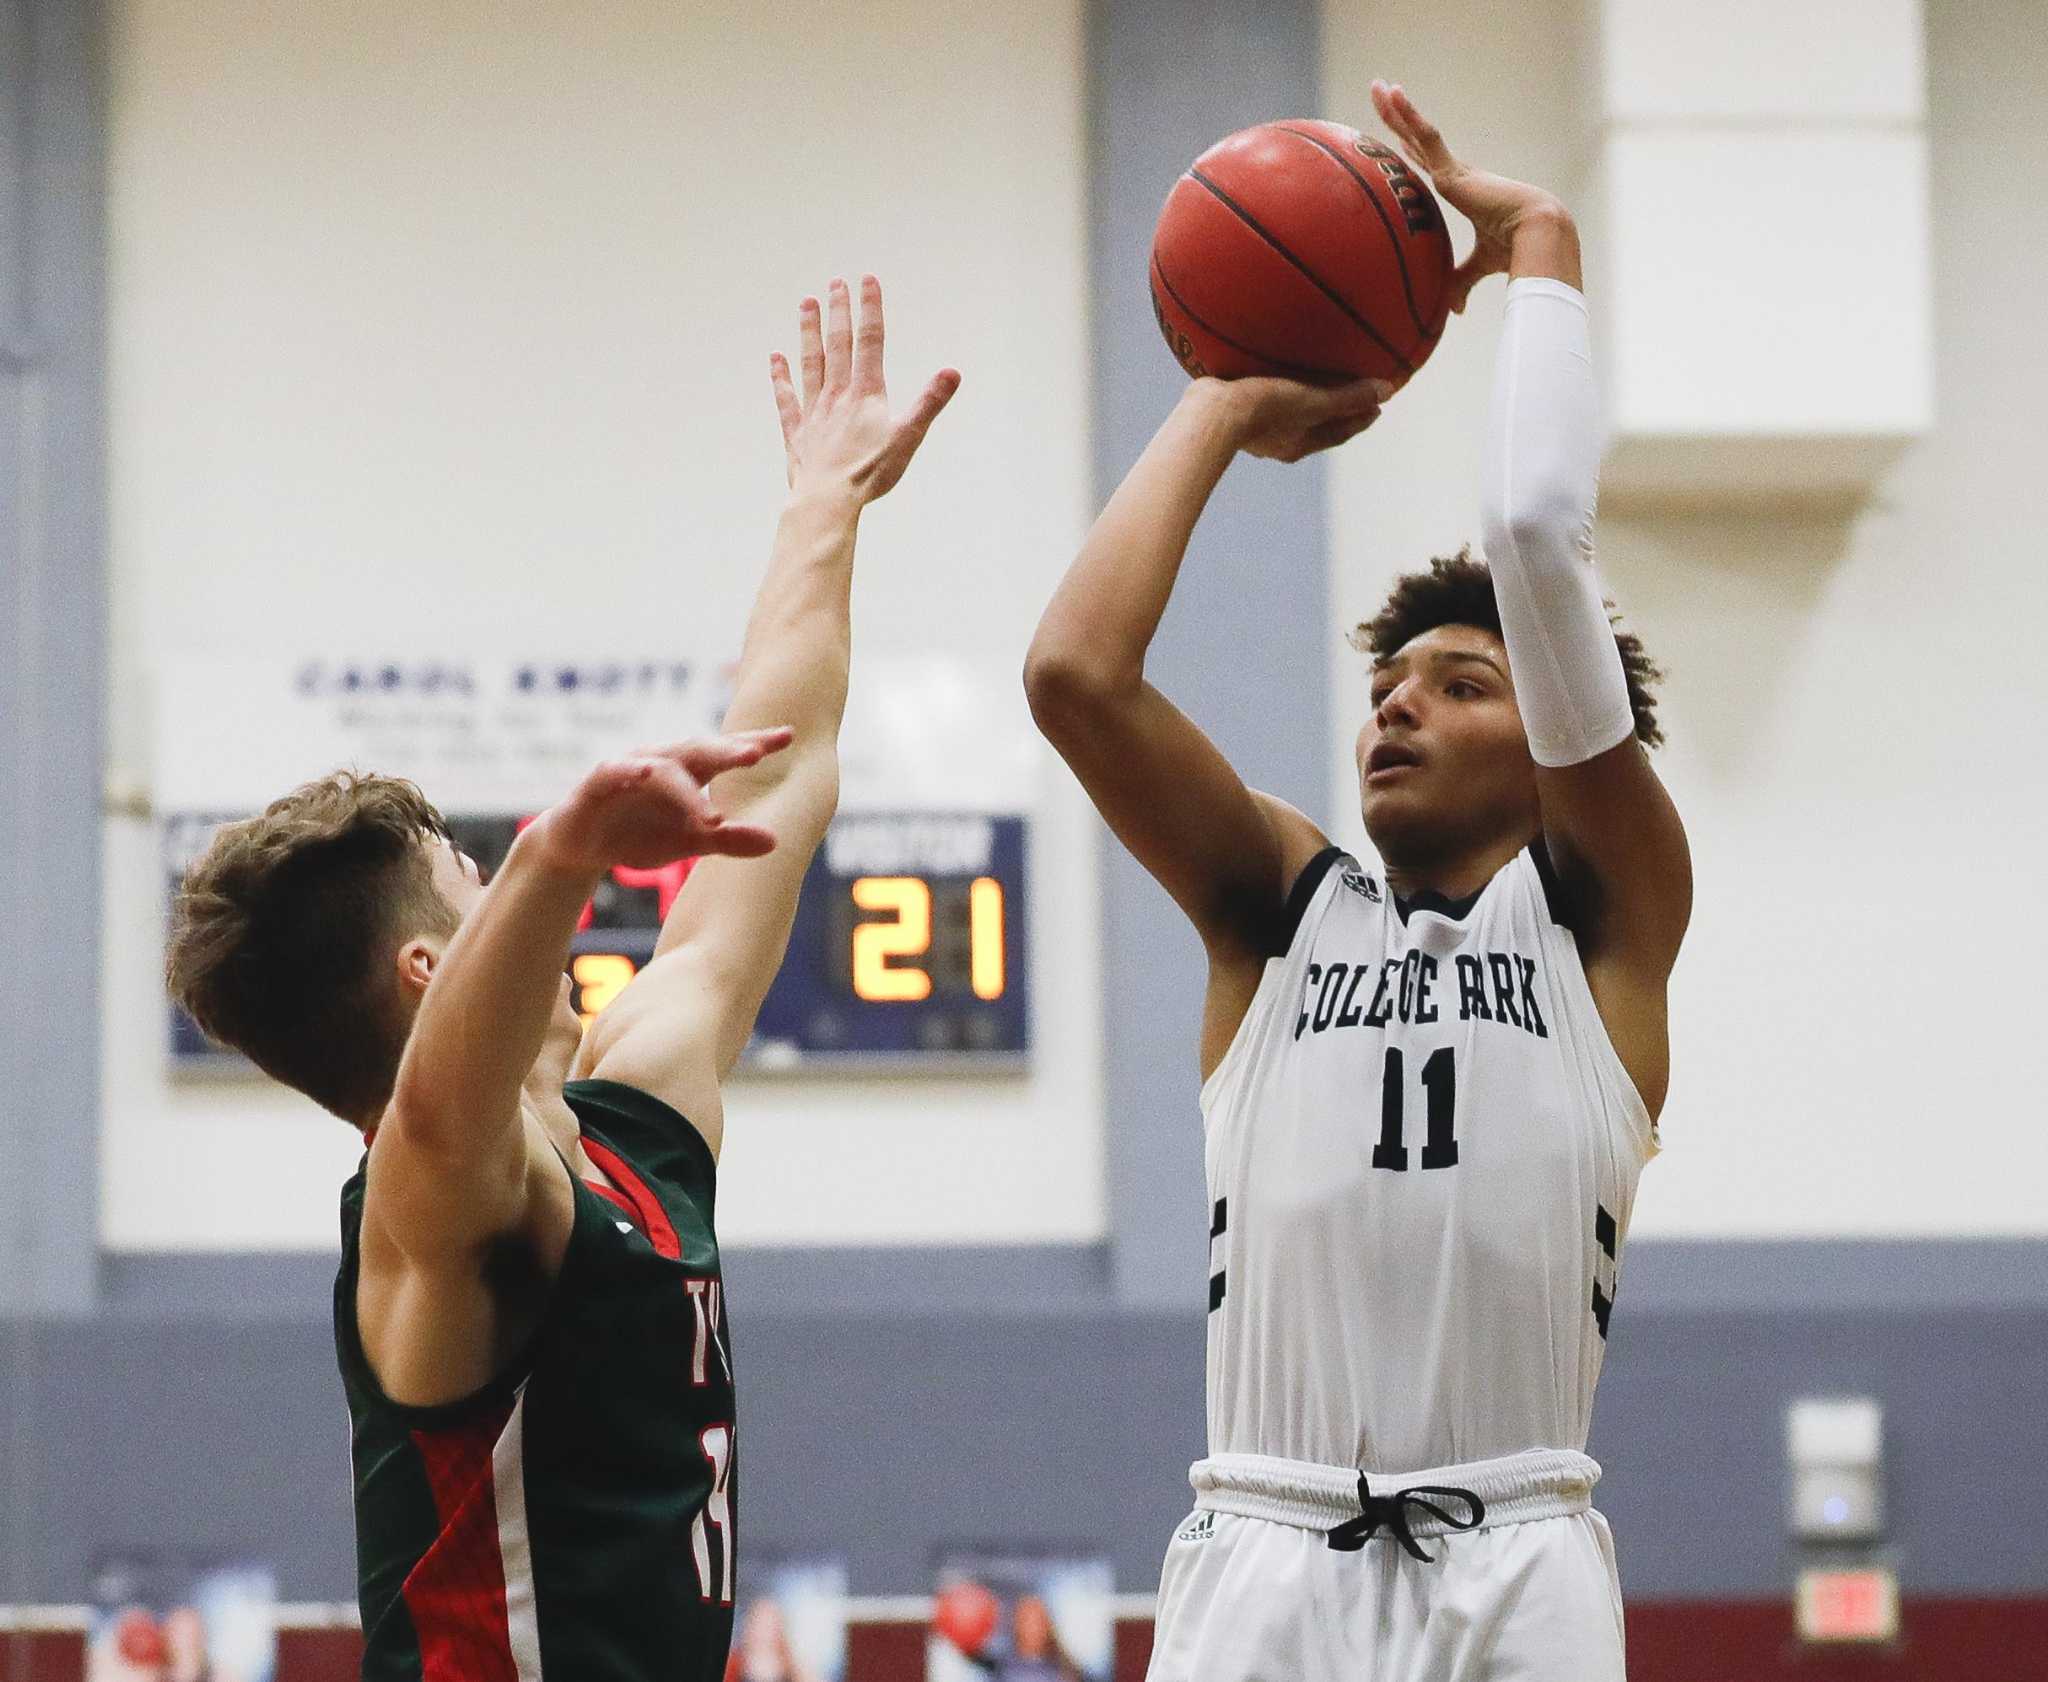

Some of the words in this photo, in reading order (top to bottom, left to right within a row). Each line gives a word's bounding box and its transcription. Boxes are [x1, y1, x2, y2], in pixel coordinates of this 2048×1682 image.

[851, 874, 1005, 1003] 21
[1455, 952, 1548, 1039] PARK
[1372, 1046, 1459, 1172] 11
